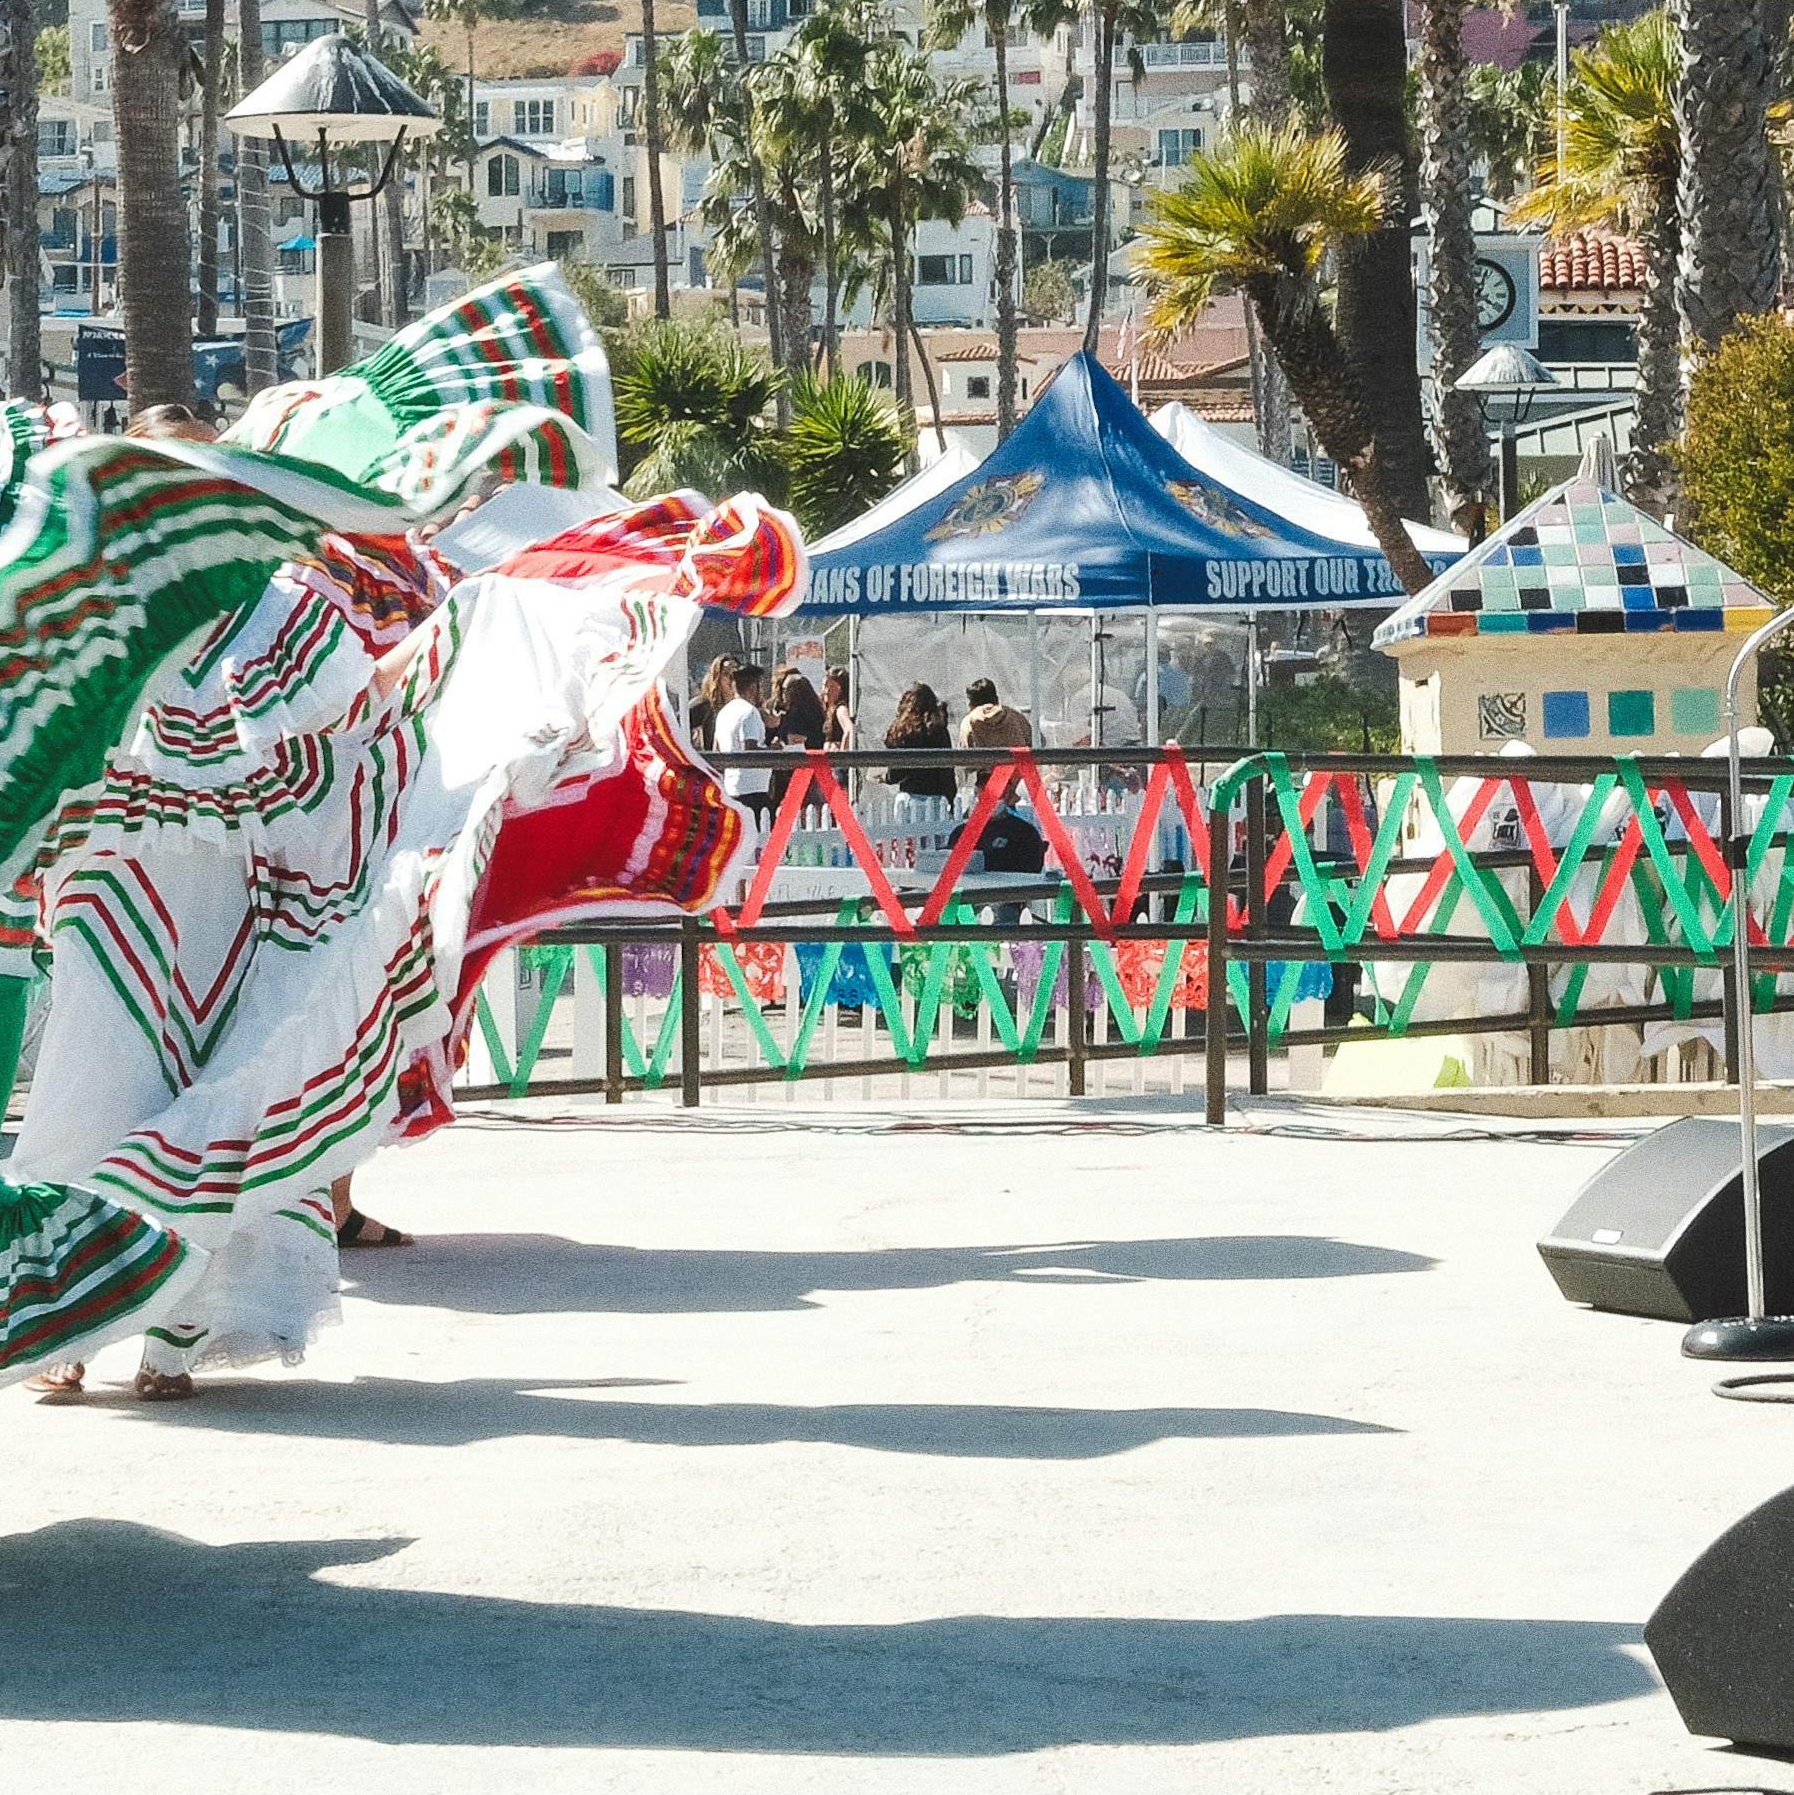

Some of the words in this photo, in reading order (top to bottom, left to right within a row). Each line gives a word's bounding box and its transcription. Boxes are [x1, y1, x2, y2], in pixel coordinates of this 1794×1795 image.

[866, 564, 896, 602] OF
[899, 563, 1000, 603] FOREIGN
[1004, 562, 1081, 601] WARS
[1206, 560, 1309, 599] SUPPORT
[1314, 558, 1360, 595] OUR
